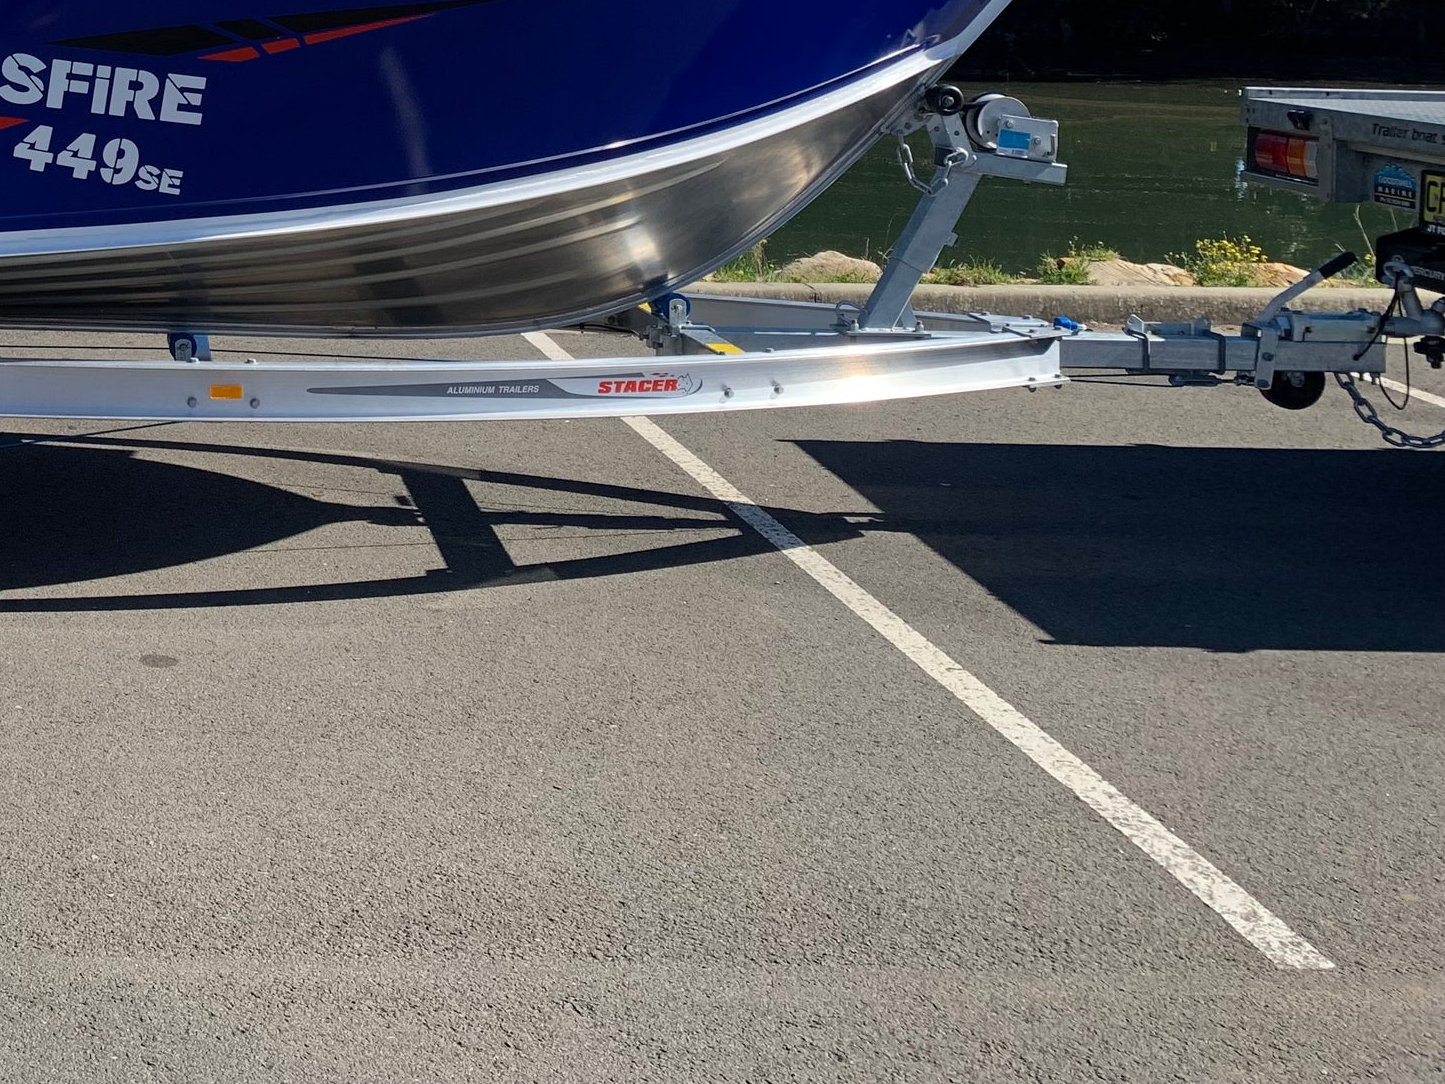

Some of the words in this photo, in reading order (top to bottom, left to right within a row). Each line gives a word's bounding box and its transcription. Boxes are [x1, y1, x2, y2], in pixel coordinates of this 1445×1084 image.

[446, 385, 496, 395] ALUMINIUM
[498, 385, 540, 394] TRAILERS
[597, 378, 678, 394] STACER
